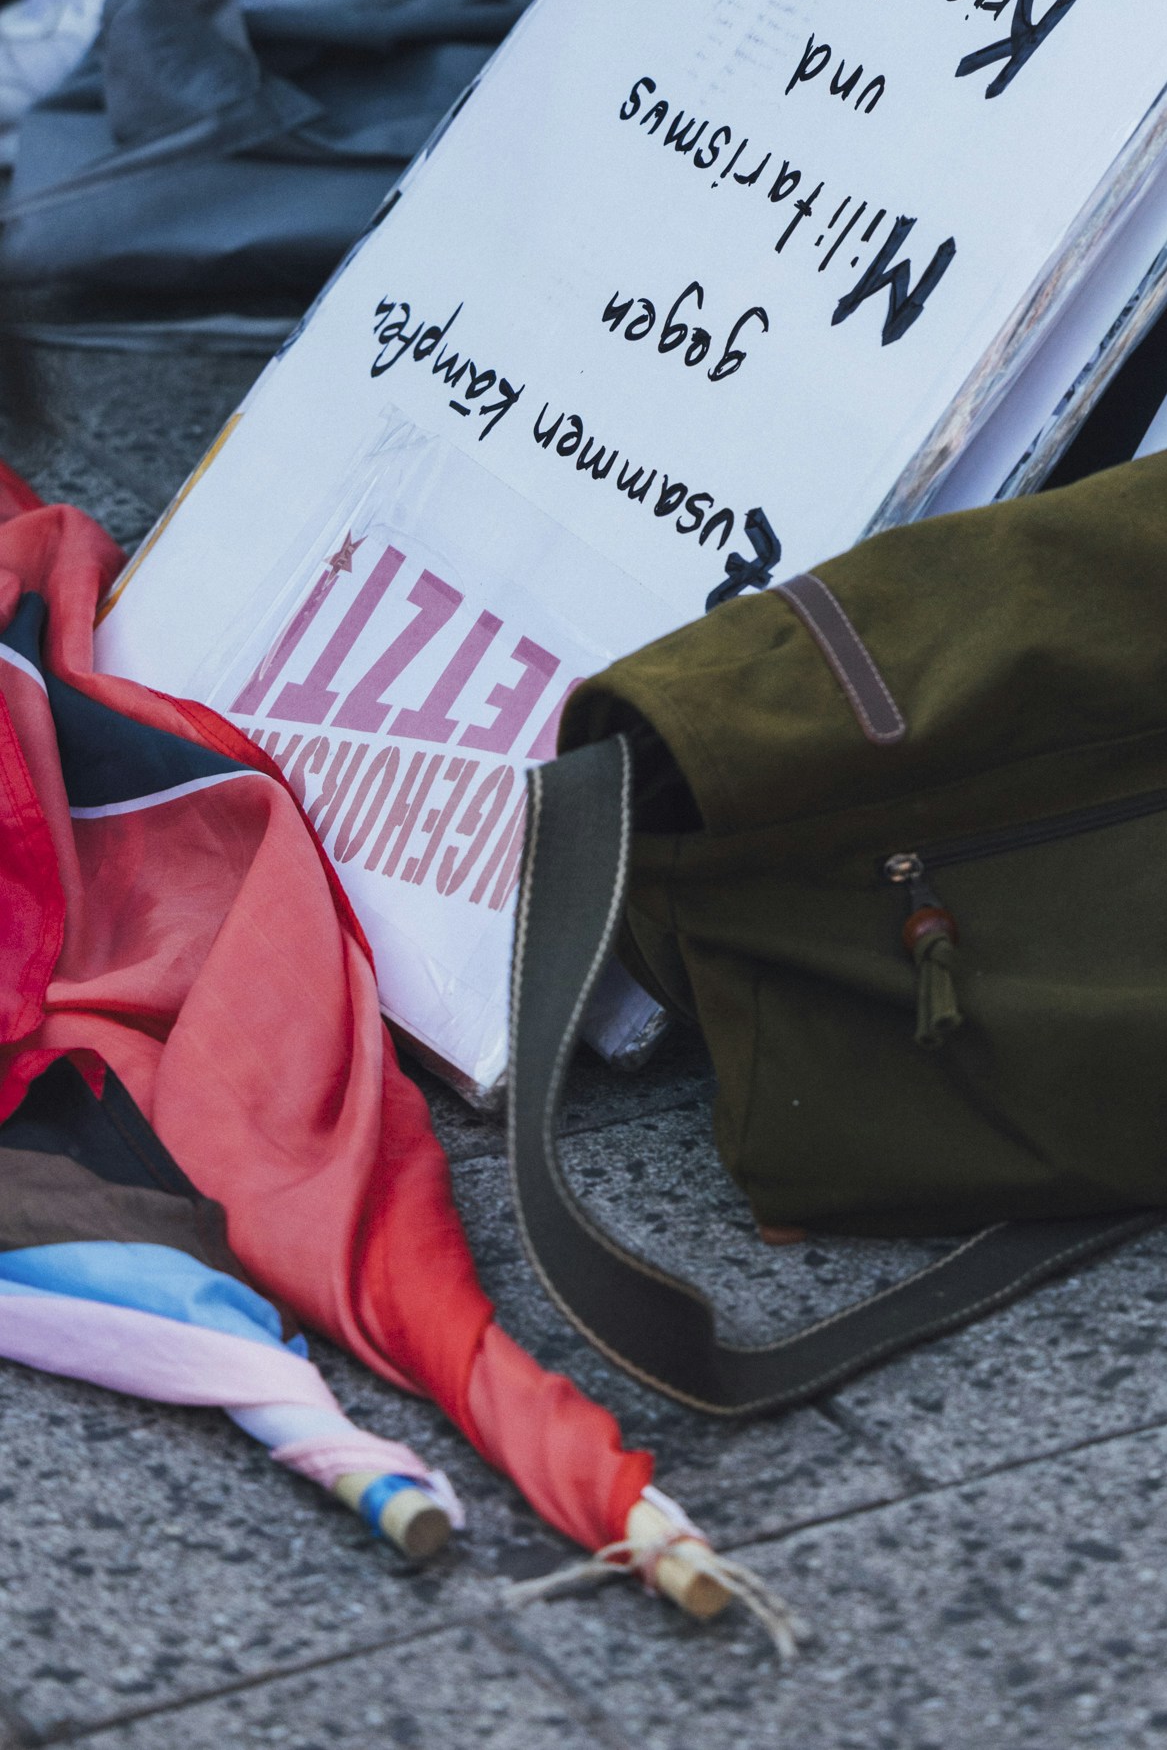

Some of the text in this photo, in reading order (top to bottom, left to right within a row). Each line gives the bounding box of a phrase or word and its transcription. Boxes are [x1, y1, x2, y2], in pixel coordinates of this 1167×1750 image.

[785, 34, 886, 114] und
[620, 77, 956, 346] Militarismus
[602, 281, 768, 381] gegen
[534, 403, 780, 609] Zusammen
